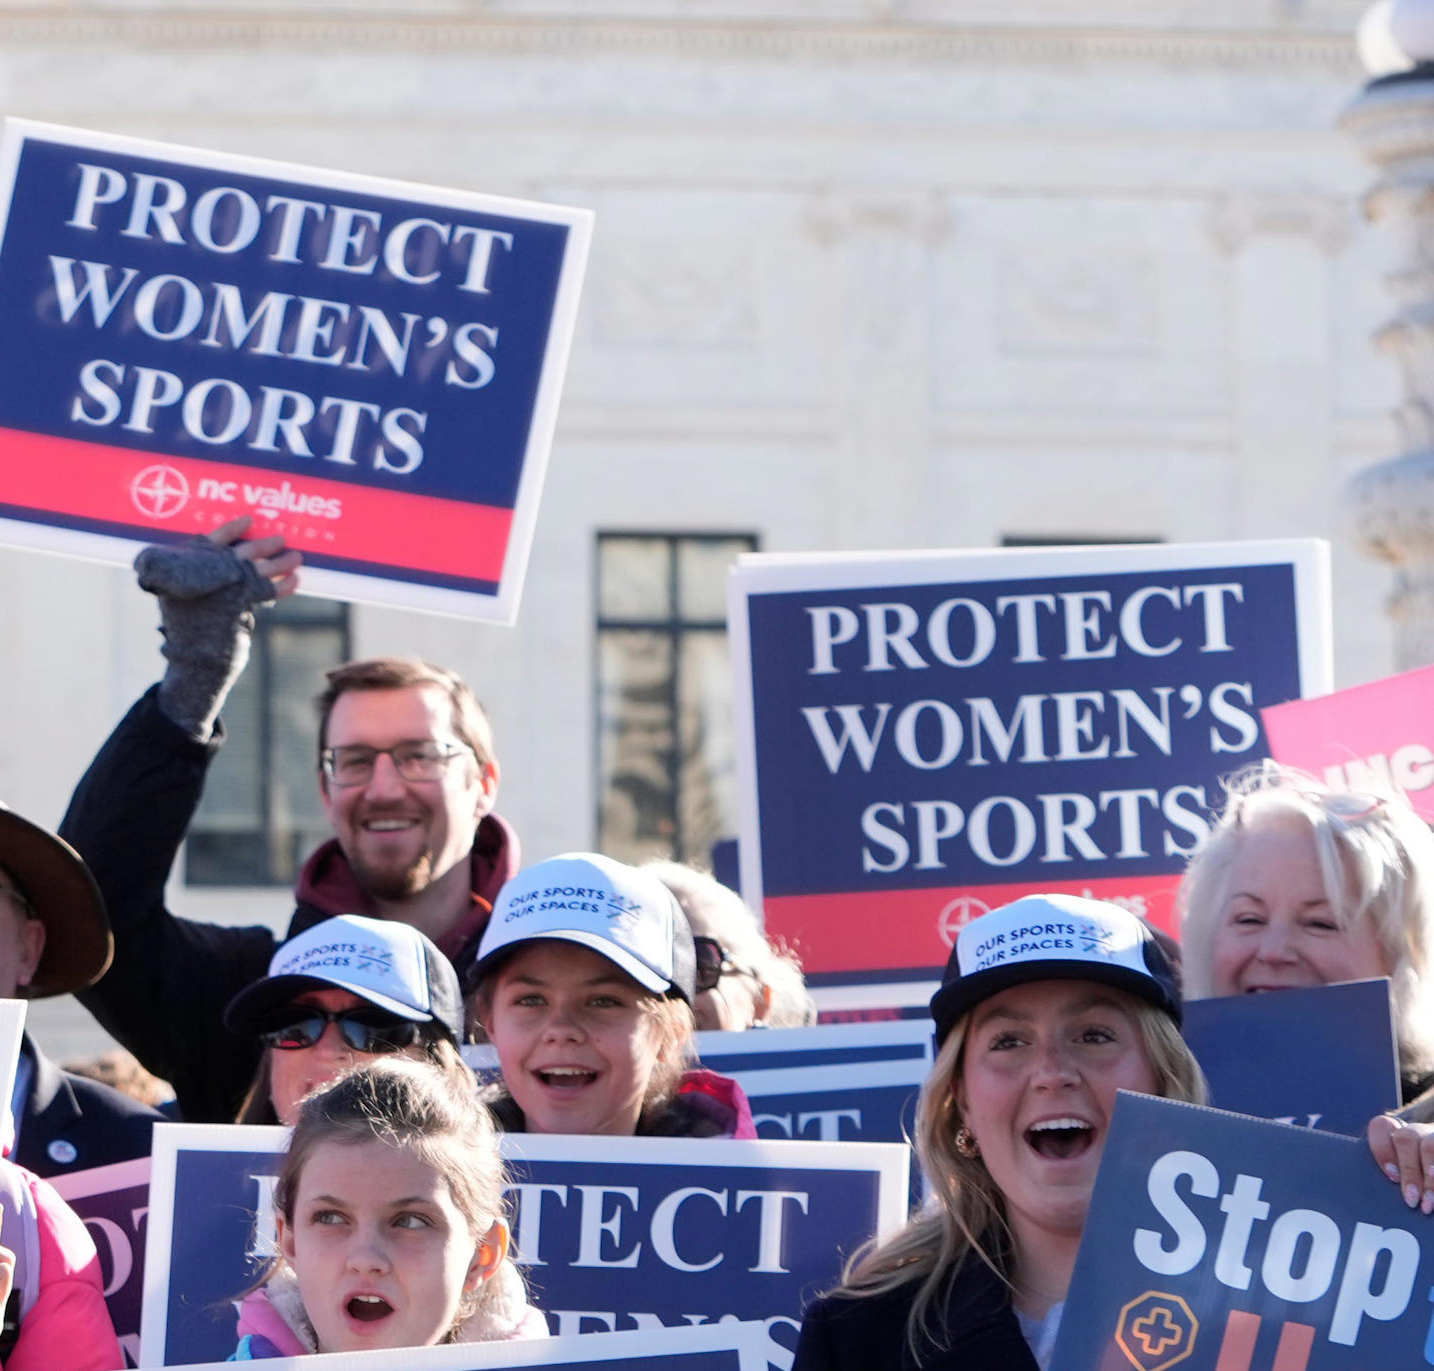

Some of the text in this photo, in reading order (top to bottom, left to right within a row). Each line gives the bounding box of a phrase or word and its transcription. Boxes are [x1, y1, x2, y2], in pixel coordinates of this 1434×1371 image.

[66, 163, 513, 294] PROTECT
[48, 255, 499, 389] WOMEN'S
[71, 359, 428, 474] SPORTS
[197, 478, 342, 519] nc values
[804, 583, 1244, 675] PROTECT
[802, 682, 1259, 774] WOMEN'S
[861, 785, 1211, 873] SPORTS
[505, 901, 599, 923] OUR SPACES
[510, 887, 605, 908] OUR SPORTS
[976, 923, 1075, 957] OUR SPORTS
[975, 939, 1074, 971] OUR SPACES
[1133, 1150, 1421, 1347] Stop
